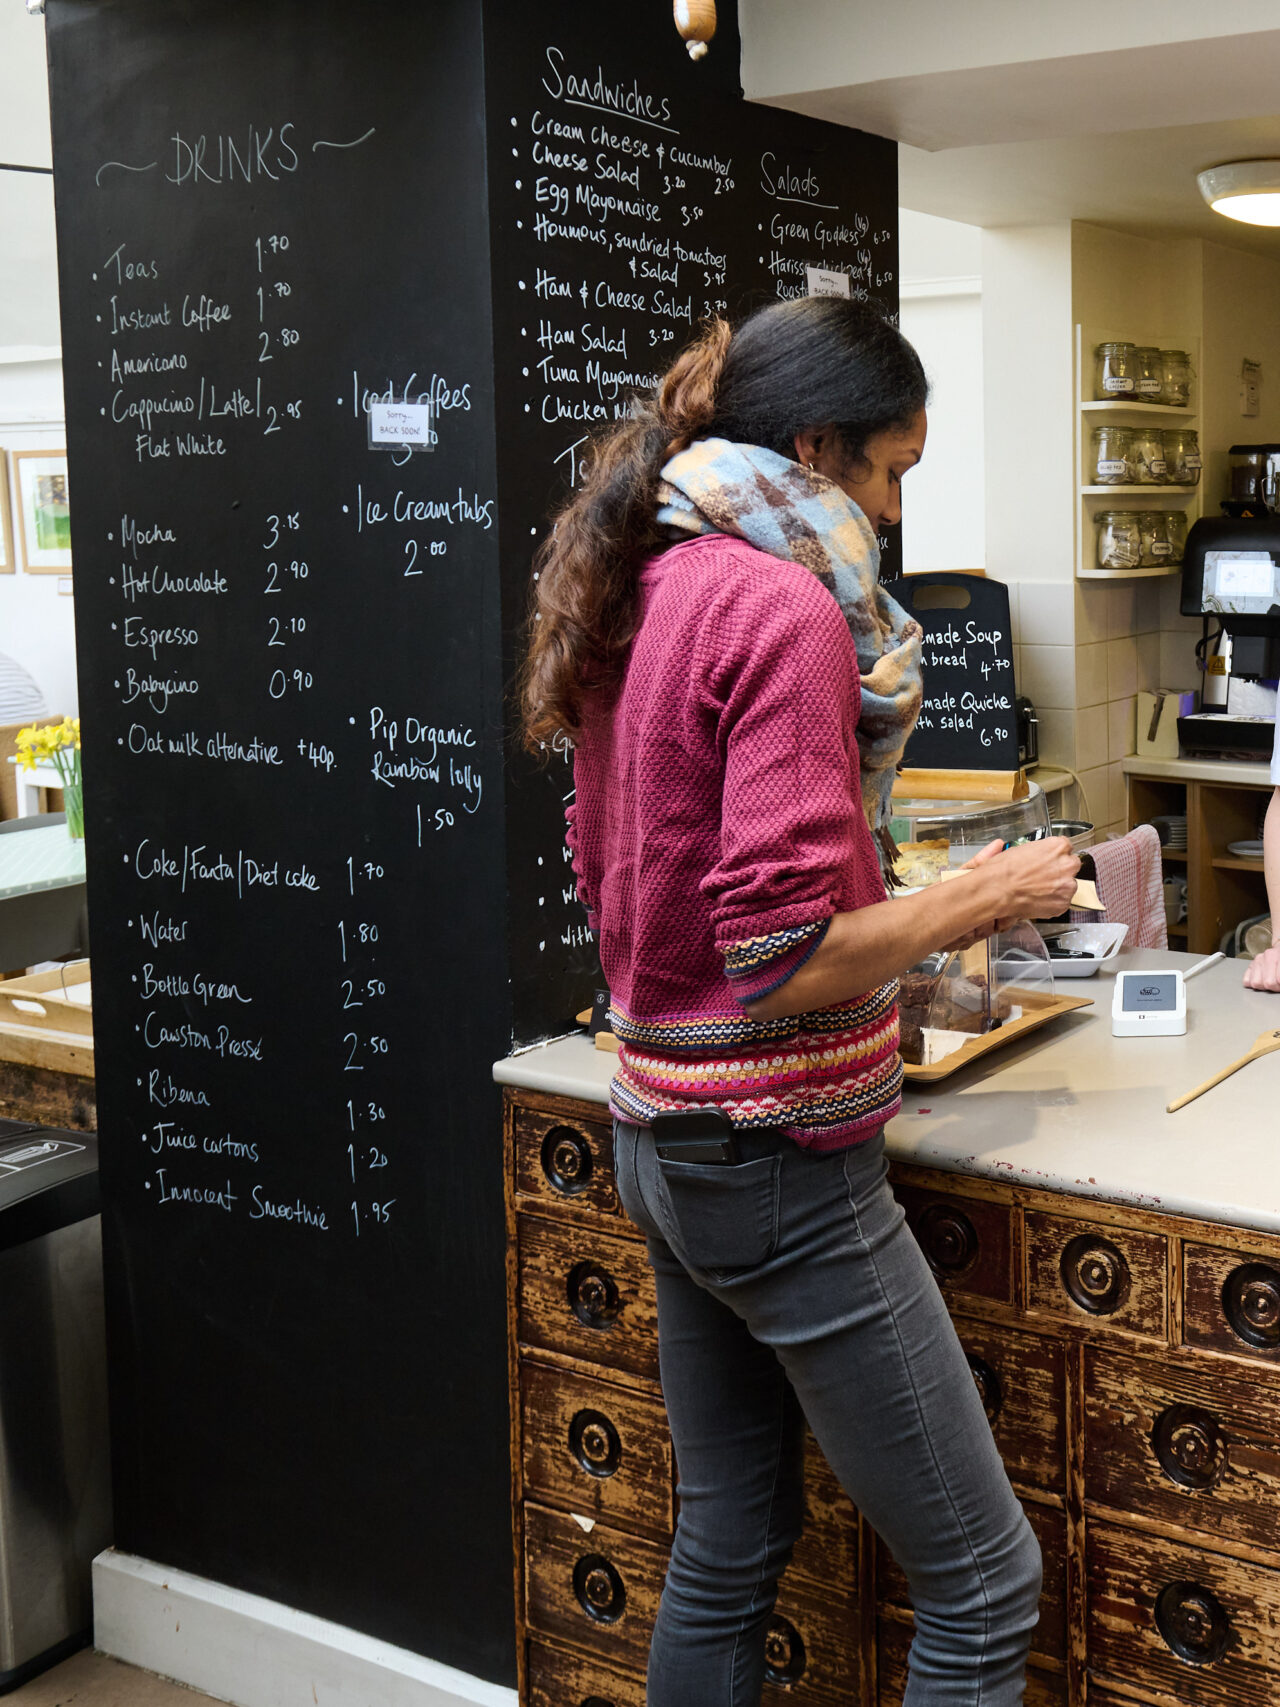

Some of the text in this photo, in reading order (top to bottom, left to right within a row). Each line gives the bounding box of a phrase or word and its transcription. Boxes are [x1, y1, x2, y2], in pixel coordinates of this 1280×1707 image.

[542, 46, 671, 121] Sandwiches
[165, 122, 299, 186] DRINKS
[531, 110, 585, 144] Cream
[591, 123, 651, 159] Cheese
[532, 141, 686, 195] Cheese Salad 3.20
[714, 178, 735, 195] 2.50
[760, 151, 819, 197] Salads
[535, 177, 703, 226] Egg Mayonnaise 3.50
[615, 233, 670, 260] sundried
[673, 241, 727, 271] tomatoes
[771, 214, 809, 245] Green
[814, 217, 860, 248] Goddess
[104, 235, 289, 285] Teas 1.70
[640, 261, 678, 285] Salad
[110, 282, 291, 334] Instant Coffee 1.70
[535, 268, 727, 325] Ham Cheese Salad 3.70
[111, 330, 300, 384] Americano 2.80
[537, 319, 674, 359] Ham Salad 3.20
[536, 355, 580, 383] Tuna
[264, 401, 301, 435] 2.95
[541, 395, 608, 423] Chicken
[136, 434, 226, 462] Flat White
[358, 484, 388, 533] Ice
[394, 490, 453, 524] Cream
[121, 512, 301, 560] Mocha 3.15
[404, 540, 447, 577] 2.00
[122, 561, 309, 602] Hot Chocolate 2.90
[125, 616, 306, 660] Espresso 2.10
[966, 621, 1002, 655] Soup
[932, 648, 967, 669] bread
[981, 660, 1011, 681] 4.70
[122, 668, 313, 714] Babycino 0.90
[961, 692, 1012, 713] Quiche
[128, 723, 164, 754] Oat
[207, 732, 283, 765] alternative
[370, 706, 476, 765] Pip Organic
[941, 713, 973, 732] salad
[981, 728, 1008, 746] 6.90
[371, 751, 482, 814] Rainbow lolly
[417, 804, 455, 848] 1.50
[285, 865, 320, 891] coke
[347, 856, 384, 895] 1.70
[140, 911, 379, 962] Water 1.80
[140, 964, 386, 1009] Bottle Green 2.50
[144, 1011, 211, 1049] Cawston
[343, 1032, 389, 1071] 2.50
[149, 1069, 210, 1107] Ribena
[347, 1100, 386, 1131] 1.30
[151, 1122, 388, 1183] Juice cartons 1.20
[155, 1168, 396, 1237] Innocent Smoothie 1.95
